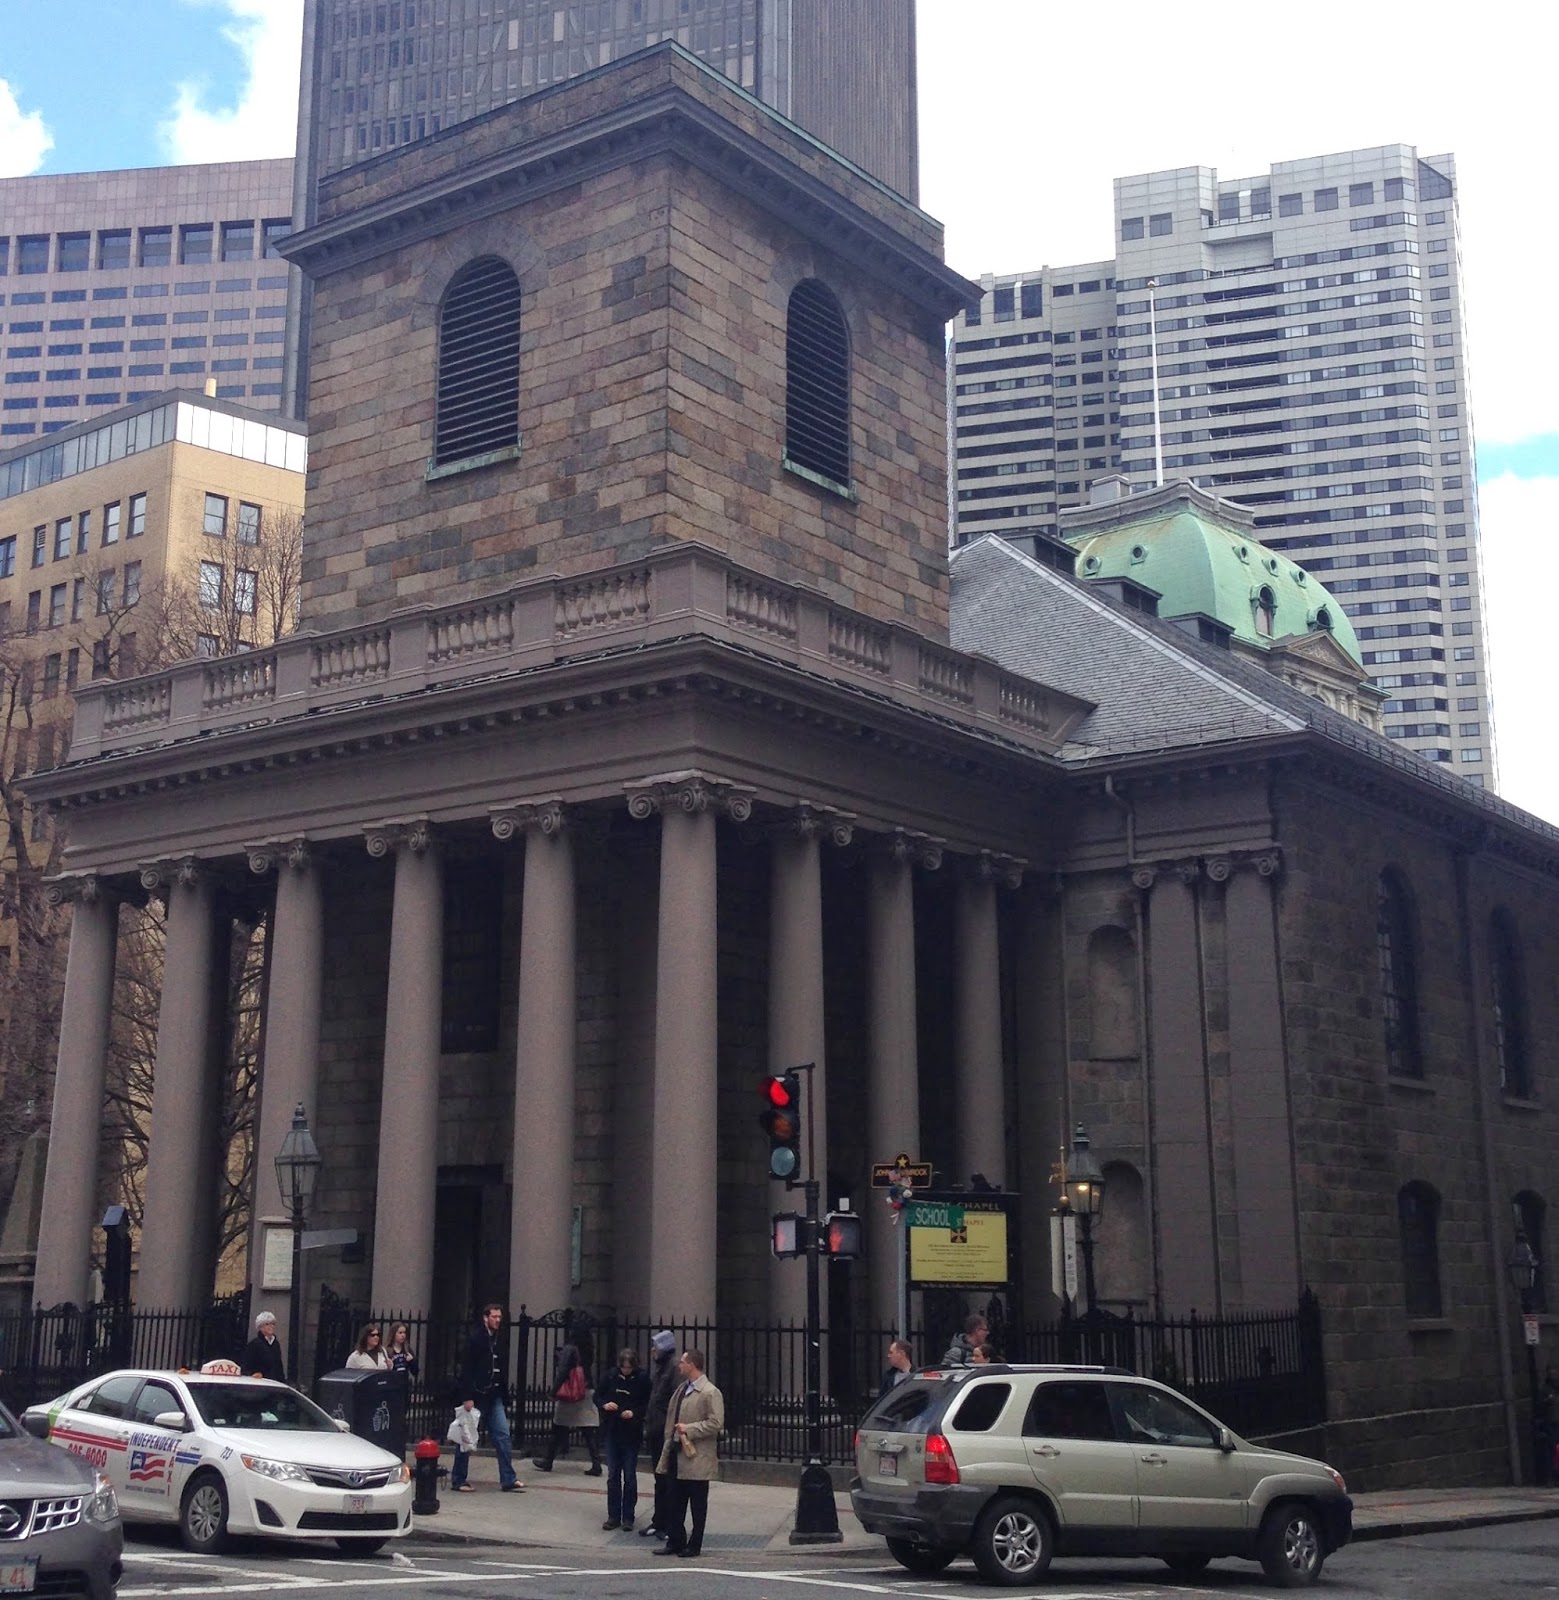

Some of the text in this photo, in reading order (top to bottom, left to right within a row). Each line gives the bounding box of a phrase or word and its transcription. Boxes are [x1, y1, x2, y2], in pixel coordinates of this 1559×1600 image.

[915, 1207, 951, 1227] SCHOOL
[209, 1364, 238, 1376] TAXI
[130, 1431, 183, 1453] INDEPENDENT
